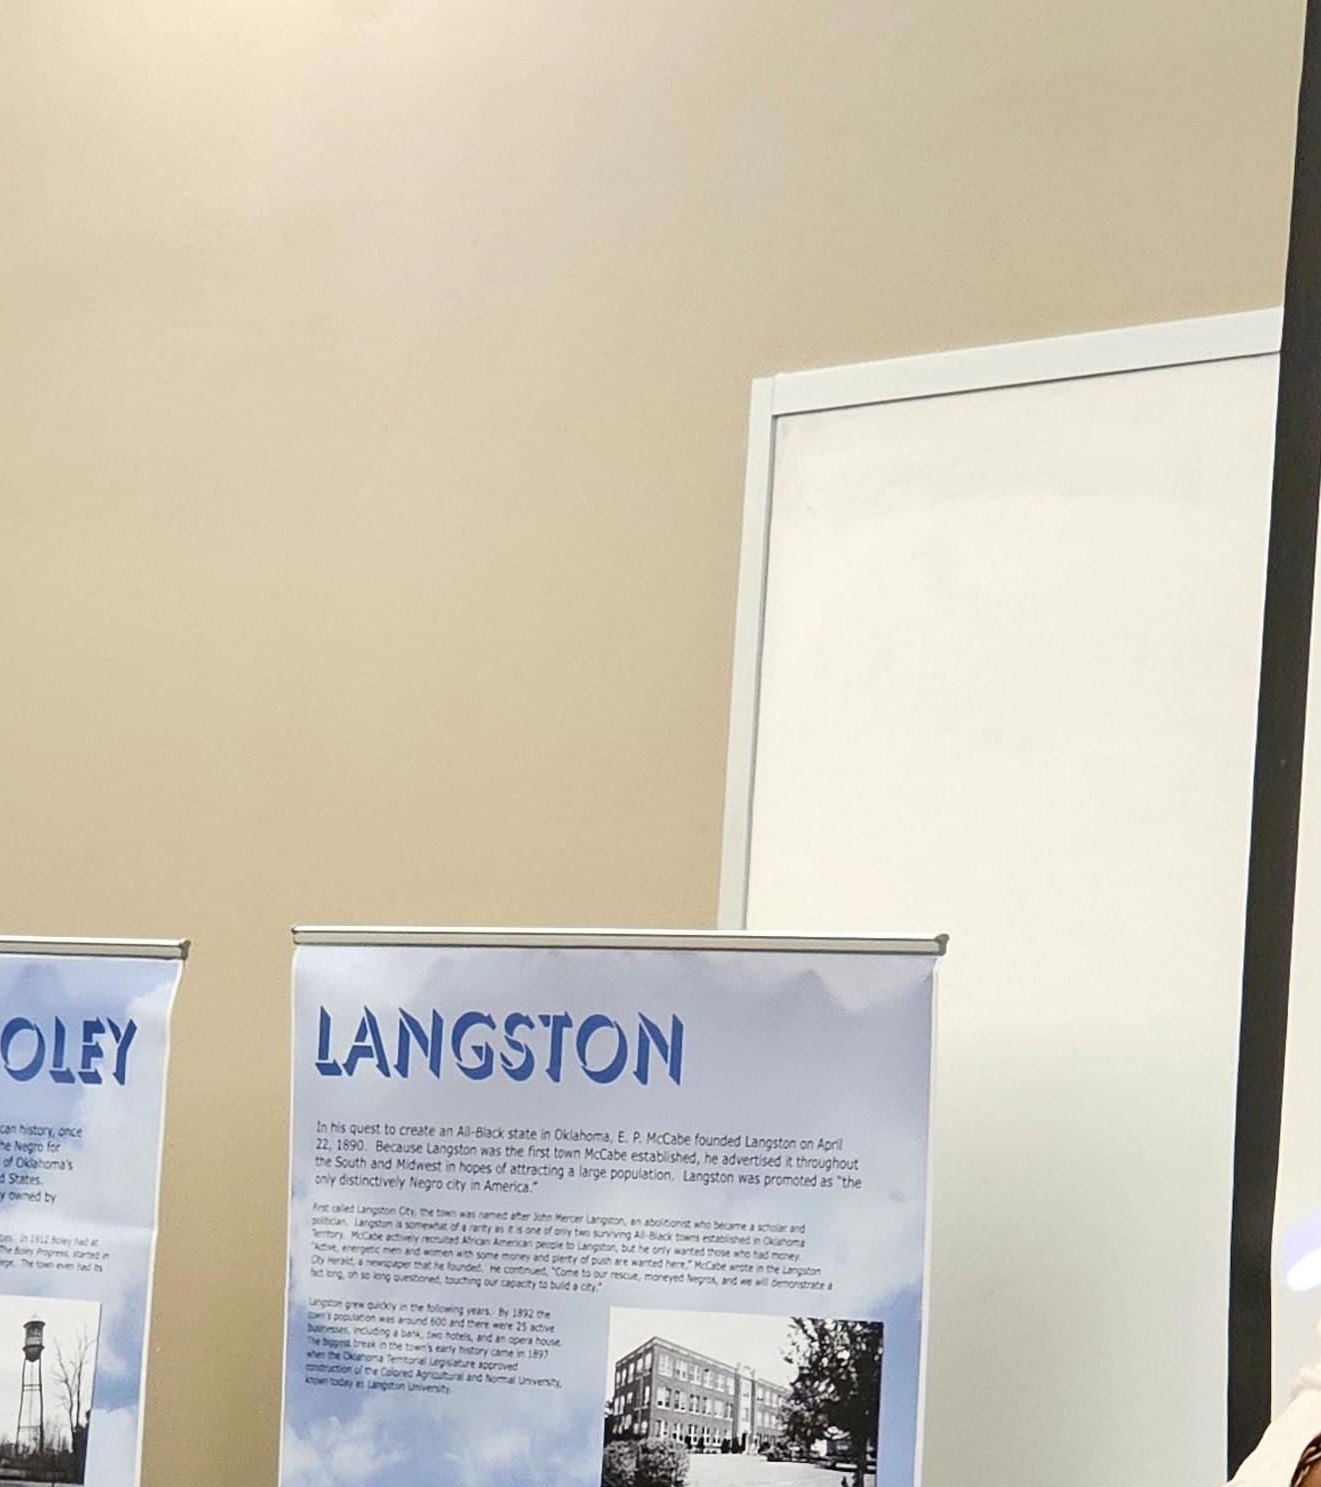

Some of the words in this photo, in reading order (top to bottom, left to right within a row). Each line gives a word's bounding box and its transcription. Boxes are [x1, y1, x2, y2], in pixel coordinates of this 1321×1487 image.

[315, 1006, 684, 1085] LANGSTON
[57, 1127, 82, 1137] once
[317, 1119, 327, 1133] In
[330, 1120, 346, 1133] his
[349, 1121, 380, 1137] quest
[384, 1121, 396, 1135] to
[399, 1122, 435, 1136] create
[439, 1126, 453, 1137] an
[457, 1123, 504, 1138] All-Black
[508, 1125, 537, 1139] state
[540, 1126, 551, 1140] in
[554, 1126, 616, 1144] Oklahoma,
[617, 1129, 629, 1142] E.
[632, 1129, 642, 1143] P.
[646, 1130, 691, 1144] McCabe
[694, 1131, 741, 1146] founded
[744, 1133, 796, 1151] Langston
[800, 1139, 814, 1149] on
[817, 1136, 843, 1153] April
[315, 1154, 331, 1168] the
[335, 1155, 366, 1169] South
[371, 1157, 392, 1170] and
[396, 1157, 441, 1172] Midwest
[445, 1159, 455, 1173] in
[459, 1159, 492, 1177] hopes
[495, 1161, 506, 1174] of
[510, 1162, 564, 1180] attracting
[568, 1167, 574, 1177] a
[579, 1164, 606, 1182] large
[610, 1166, 677, 1183] population.
[683, 1168, 734, 1186] Langston
[738, 1174, 760, 1184] was
[764, 1173, 817, 1188] promoted
[820, 1177, 833, 1187] as
[837, 1174, 861, 1188] "the
[316, 1138, 332, 1153] 22,
[337, 1137, 371, 1152] 1890.
[375, 1138, 422, 1153] Because
[426, 1140, 477, 1158] Langston
[480, 1145, 501, 1156] was
[505, 1143, 524, 1156] the
[528, 1143, 550, 1157] first
[554, 1144, 580, 1158] town
[584, 1145, 627, 1160] McCabe
[631, 1148, 702, 1166] established,
[704, 1150, 718, 1164] he
[722, 1151, 781, 1166] advertised
[785, 1153, 792, 1167] it
[796, 1154, 858, 1172] throughout
[315, 1173, 335, 1190] only
[339, 1173, 405, 1192] distinctively
[409, 1176, 443, 1193] Negro
[446, 1177, 466, 1194] city
[470, 1177, 480, 1191] in
[484, 1178, 537, 1193] America."
